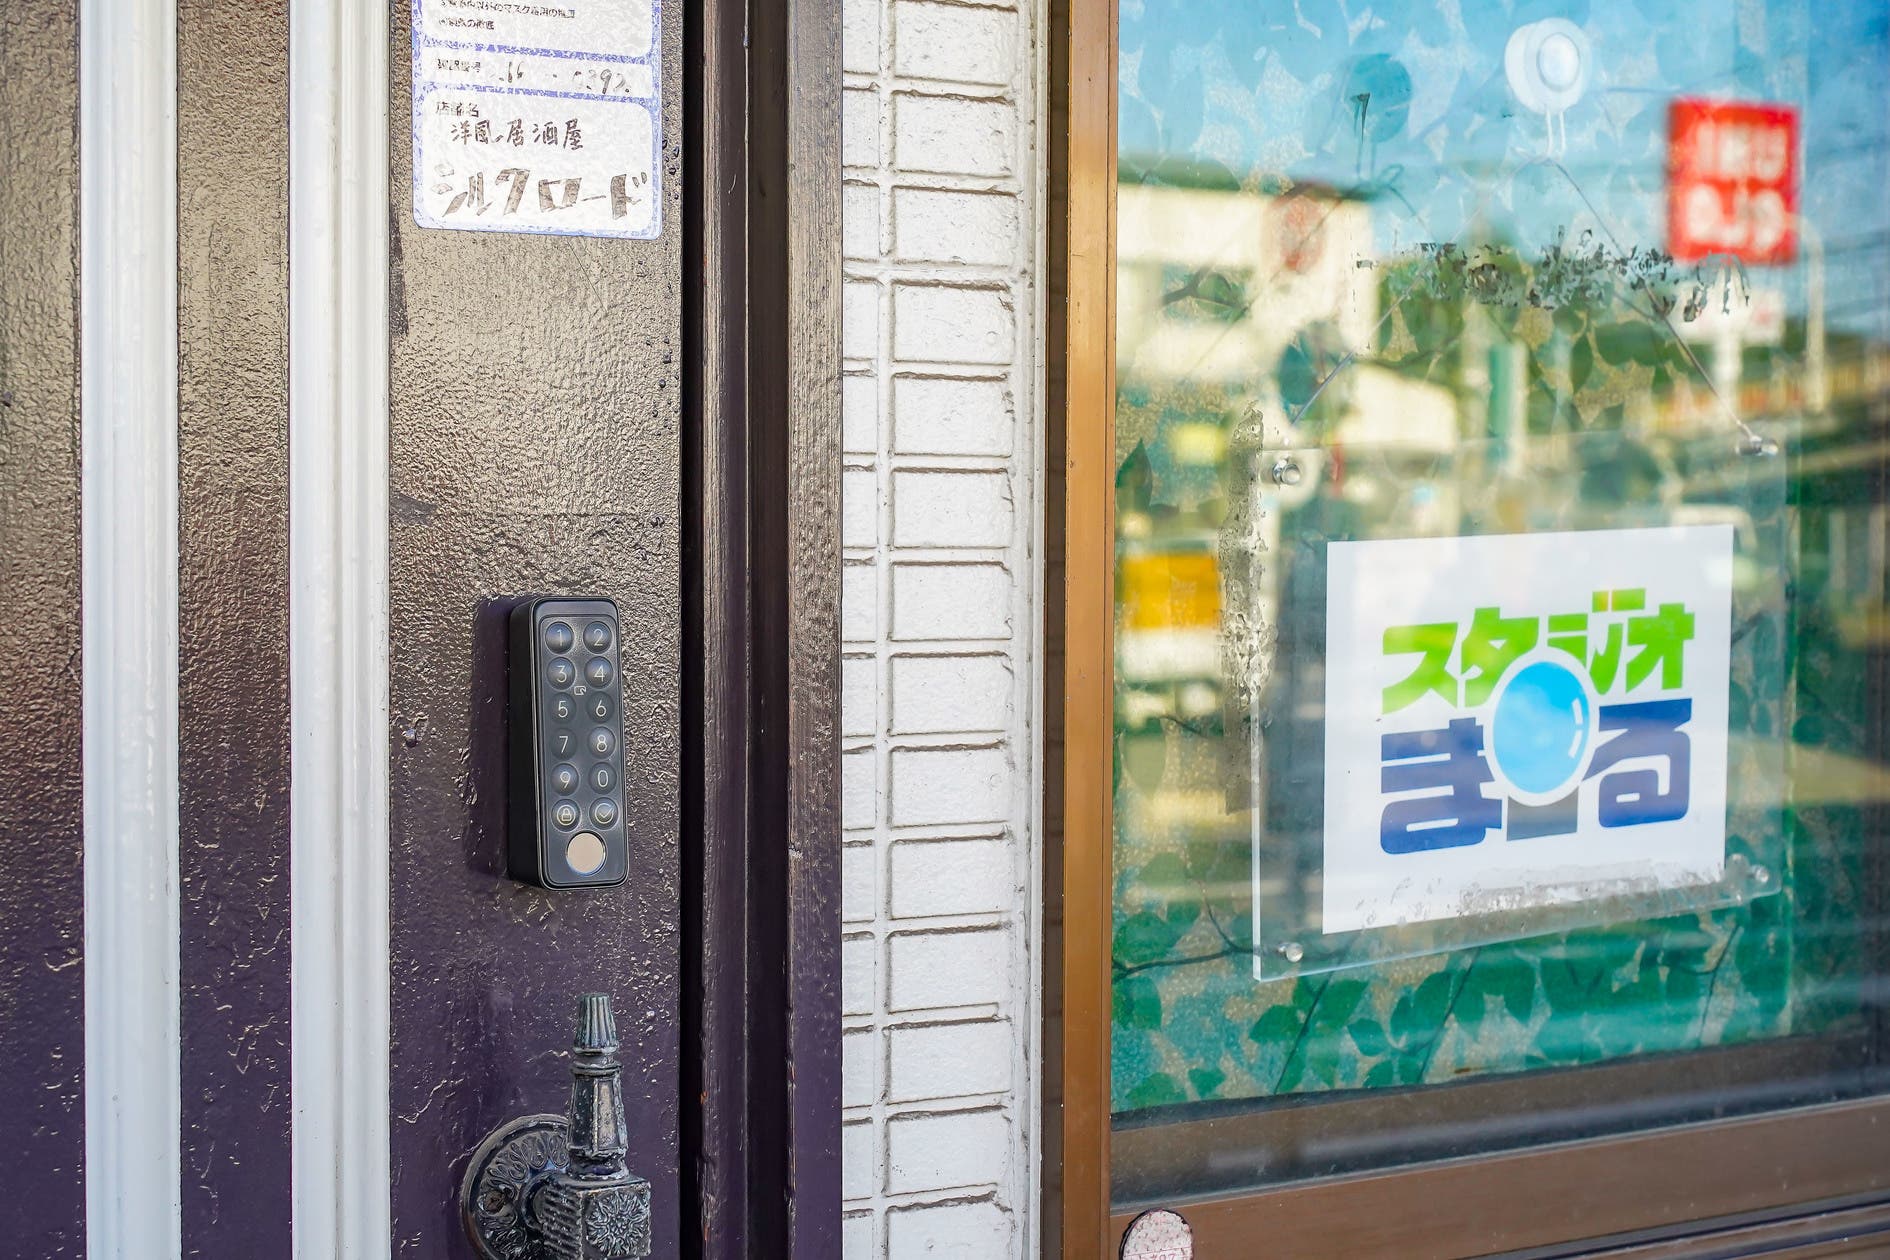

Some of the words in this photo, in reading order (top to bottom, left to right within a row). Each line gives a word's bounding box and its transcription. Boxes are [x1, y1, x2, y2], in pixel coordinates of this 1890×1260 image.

[451, 118, 584, 150] 洋風居酒屋
[431, 162, 648, 220] シルクロード
[557, 629, 564, 646] 1
[593, 629, 603, 647] 2
[1382, 588, 1695, 714] スタジオ
[556, 665, 567, 683] 3
[593, 664, 606, 682] 4
[557, 700, 569, 718] 5
[595, 699, 607, 717] 6
[558, 735, 569, 753] 7
[596, 734, 608, 752] 8
[559, 771, 571, 789] 9
[597, 769, 609, 787] 0
